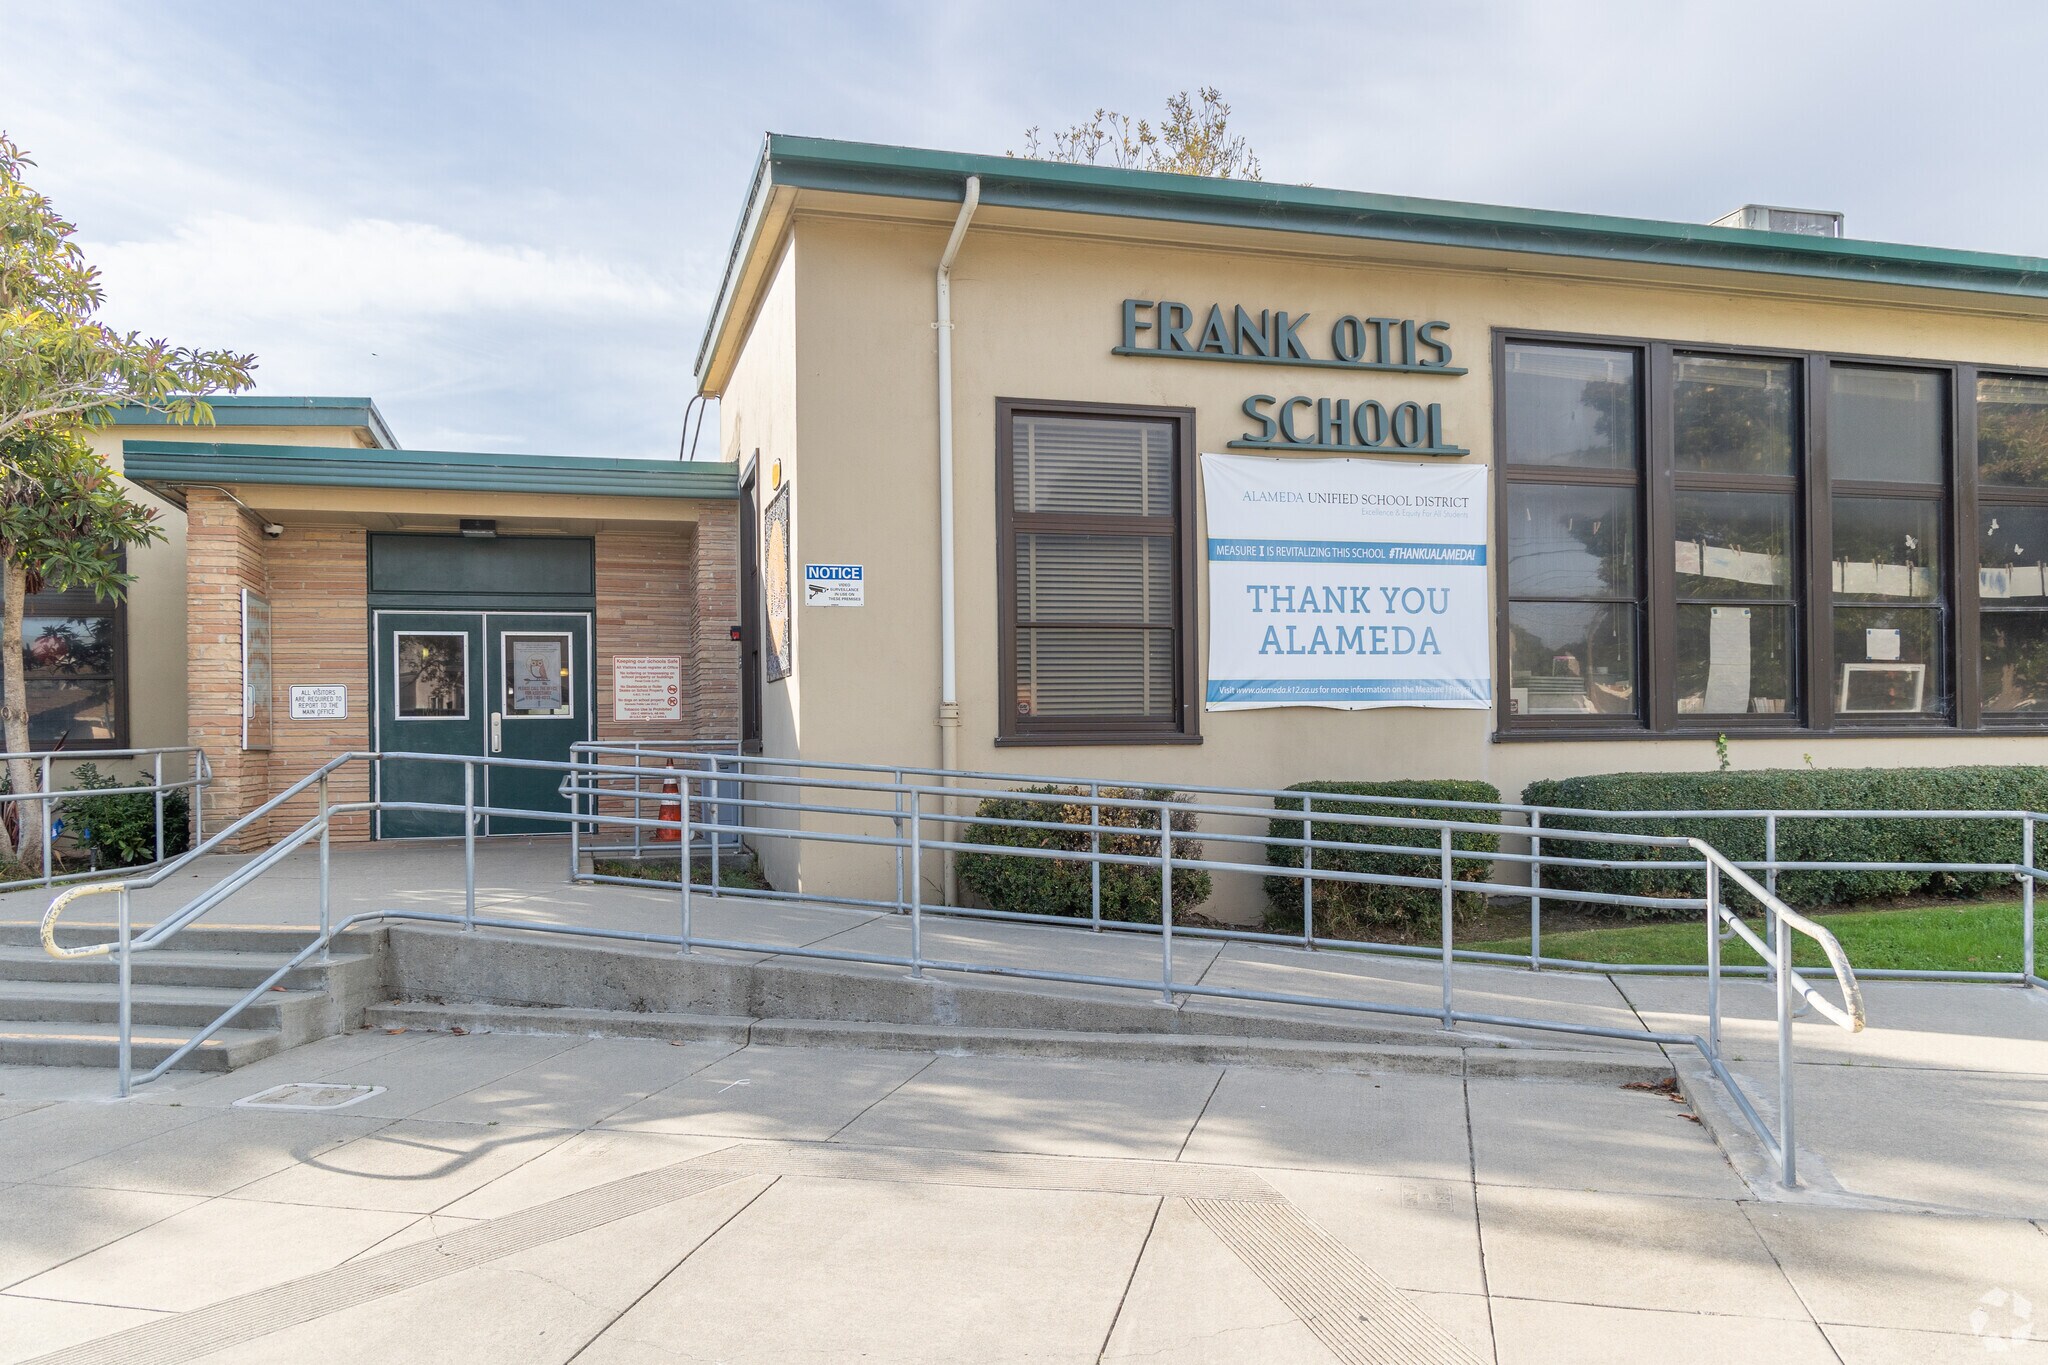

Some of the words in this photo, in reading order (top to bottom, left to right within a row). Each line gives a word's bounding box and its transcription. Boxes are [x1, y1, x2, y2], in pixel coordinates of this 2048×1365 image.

[1122, 299, 1311, 360] FRANK
[1331, 314, 1454, 367] OTIS
[1242, 394, 1459, 449] SCHOOL
[1242, 490, 1304, 503] ALAMEDA
[1308, 492, 1359, 505] UNIFIED
[1361, 493, 1413, 507] SCHOOL
[1415, 496, 1469, 508] DISTRICT
[1361, 507, 1394, 517] Excellence
[1395, 509, 1400, 517] &
[1402, 509, 1421, 518] Equity
[1422, 510, 1432, 518] For
[1433, 510, 1442, 518] All
[1443, 510, 1469, 519] Students
[1216, 545, 1257, 556] MEASURE
[1259, 545, 1265, 557] I
[1266, 546, 1274, 557] IS
[1276, 546, 1331, 558] REVITALIZING
[1332, 547, 1350, 558] THIS
[1352, 547, 1386, 559] SCHOOL
[1388, 547, 1476, 561] #THANKUALAMEDA!
[808, 566, 860, 579] NOTICE
[1246, 585, 1371, 614] THANK
[1379, 586, 1451, 615] YOU
[1258, 625, 1442, 656] ALAMEDA
[1219, 685, 1235, 694] Visit
[1236, 685, 1319, 695] www.alameda.k12.ca.us
[1319, 686, 1330, 694] for
[1350, 686, 1389, 694] information
[1402, 686, 1415, 694] the
[1415, 686, 1444, 694] Measure
